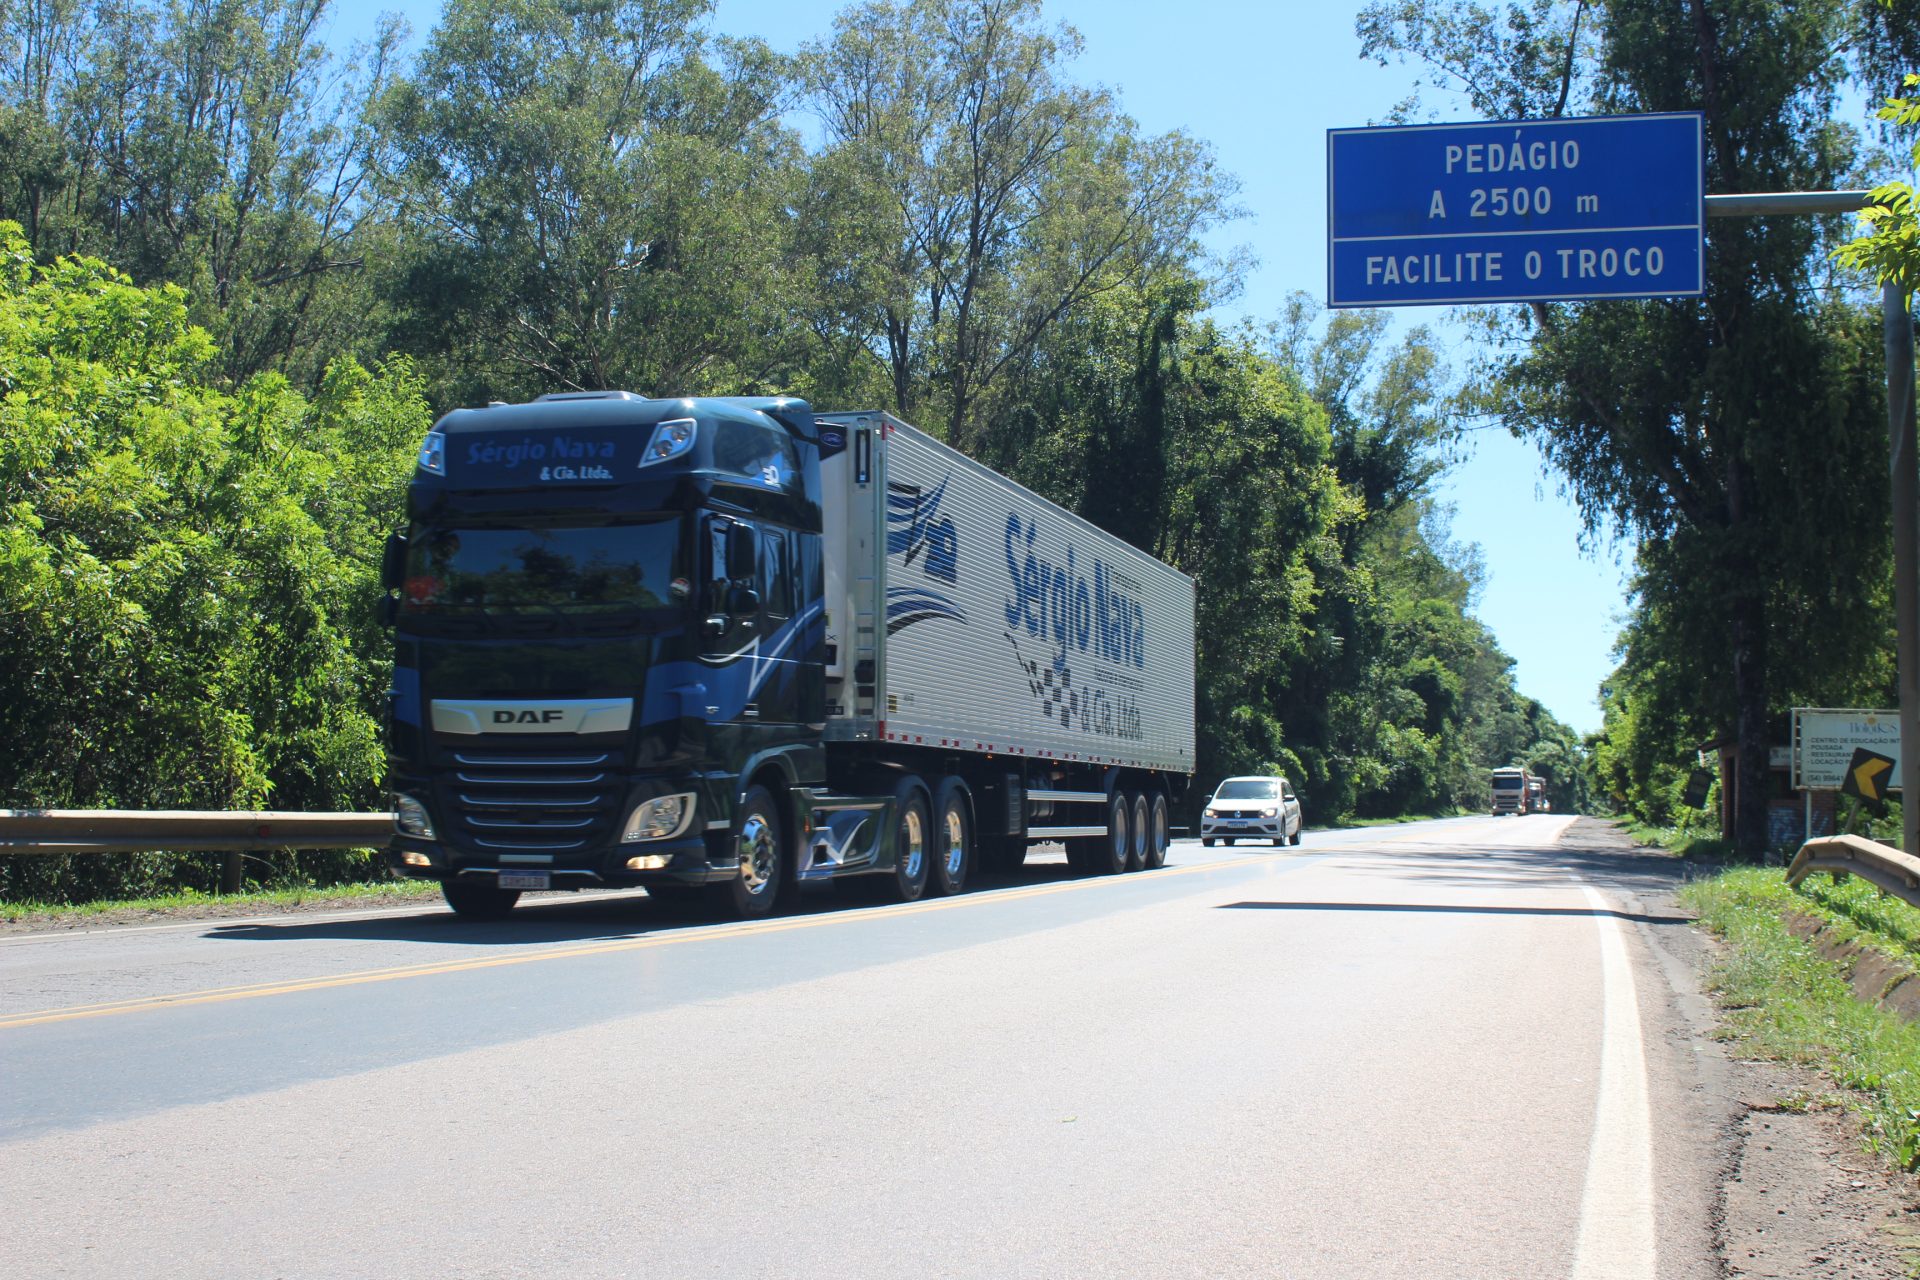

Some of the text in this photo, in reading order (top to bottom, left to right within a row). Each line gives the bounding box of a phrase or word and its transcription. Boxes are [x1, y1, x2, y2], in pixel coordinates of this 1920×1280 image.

[1446, 130, 1580, 174] PEDÁGIO
[1429, 186, 1598, 219] A 2500 m
[1366, 246, 1664, 285] FACILITE O TROCO
[466, 436, 616, 468] Sérgio Nava
[540, 466, 551, 481] &
[580, 465, 614, 480] Ltda.
[1004, 511, 1144, 675] Sérgio Nava
[493, 710, 564, 724] DAF
[1081, 686, 1091, 733] &
[1850, 736, 1888, 745] EDUCAÇÃO
